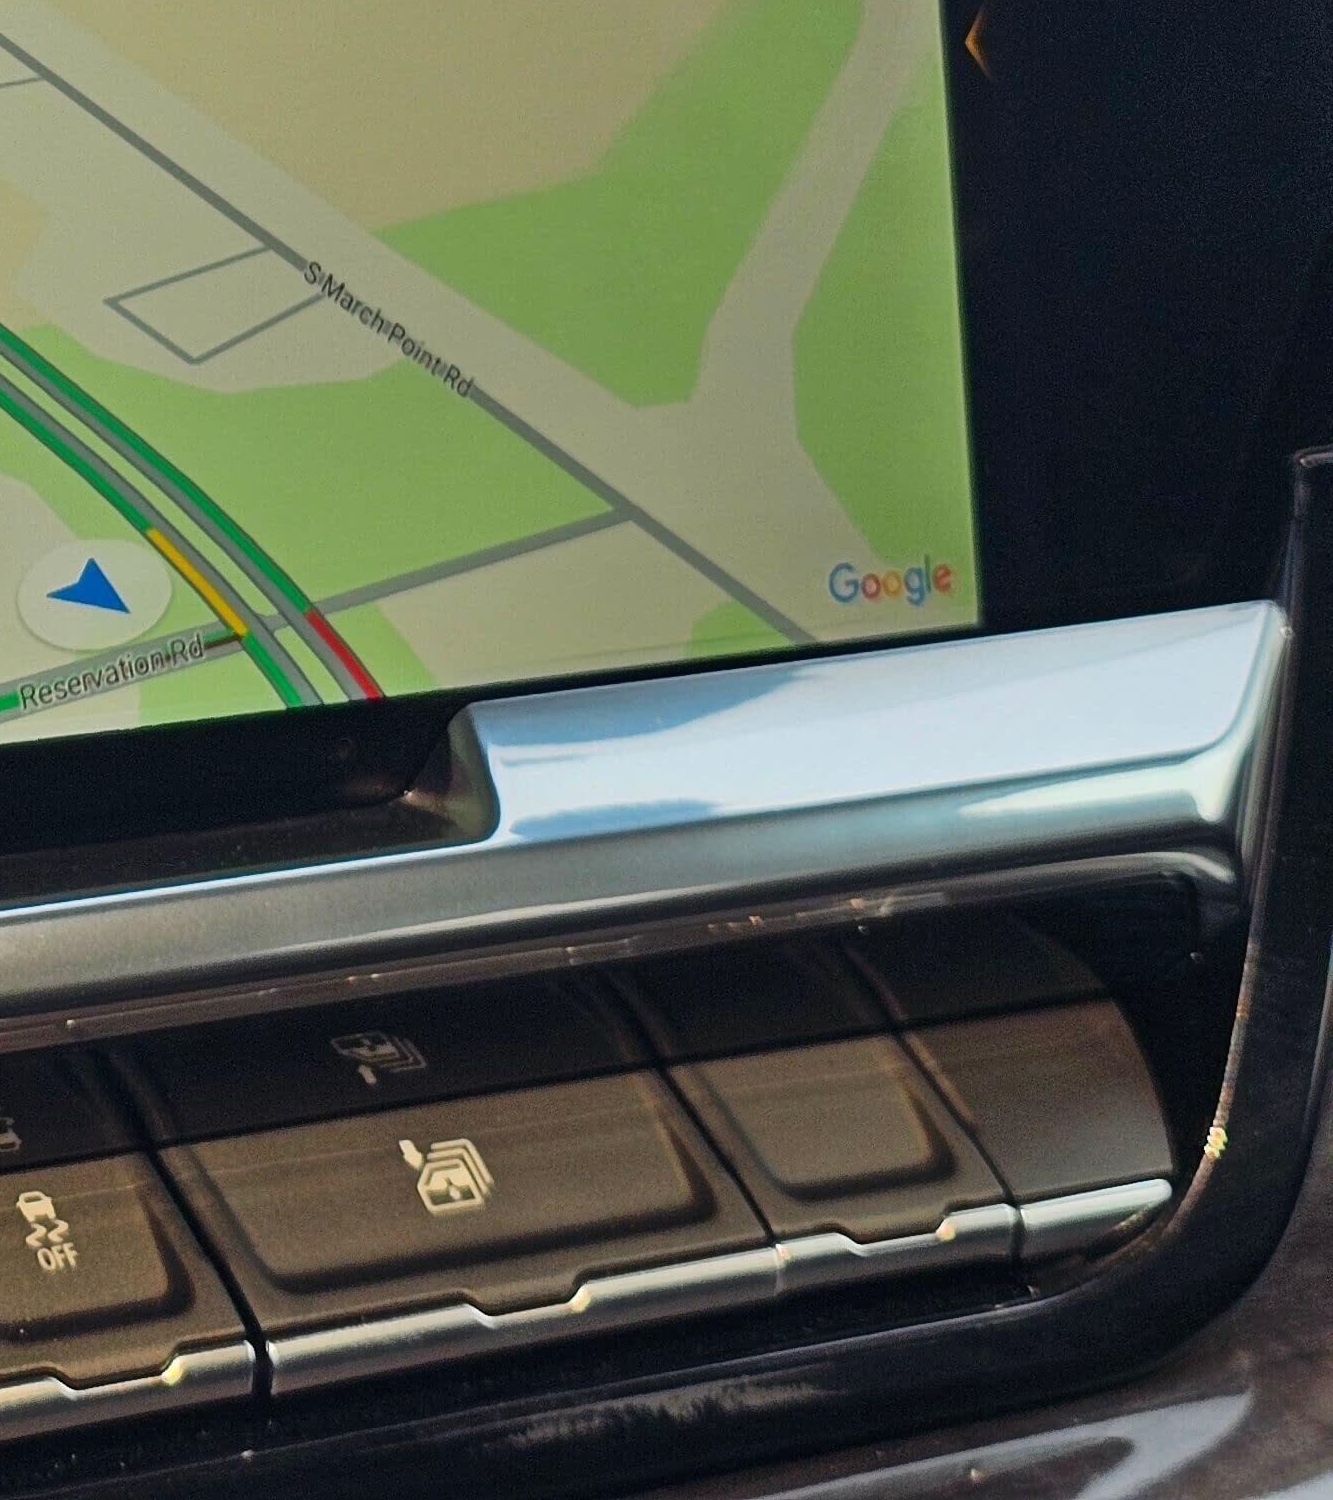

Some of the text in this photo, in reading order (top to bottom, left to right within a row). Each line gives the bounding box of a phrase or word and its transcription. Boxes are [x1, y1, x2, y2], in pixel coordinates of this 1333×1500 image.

[303, 261, 475, 399] S March Point Rd
[828, 554, 953, 607] Google
[20, 633, 206, 710] Reservation Rd
[37, 1242, 78, 1271] OFF
